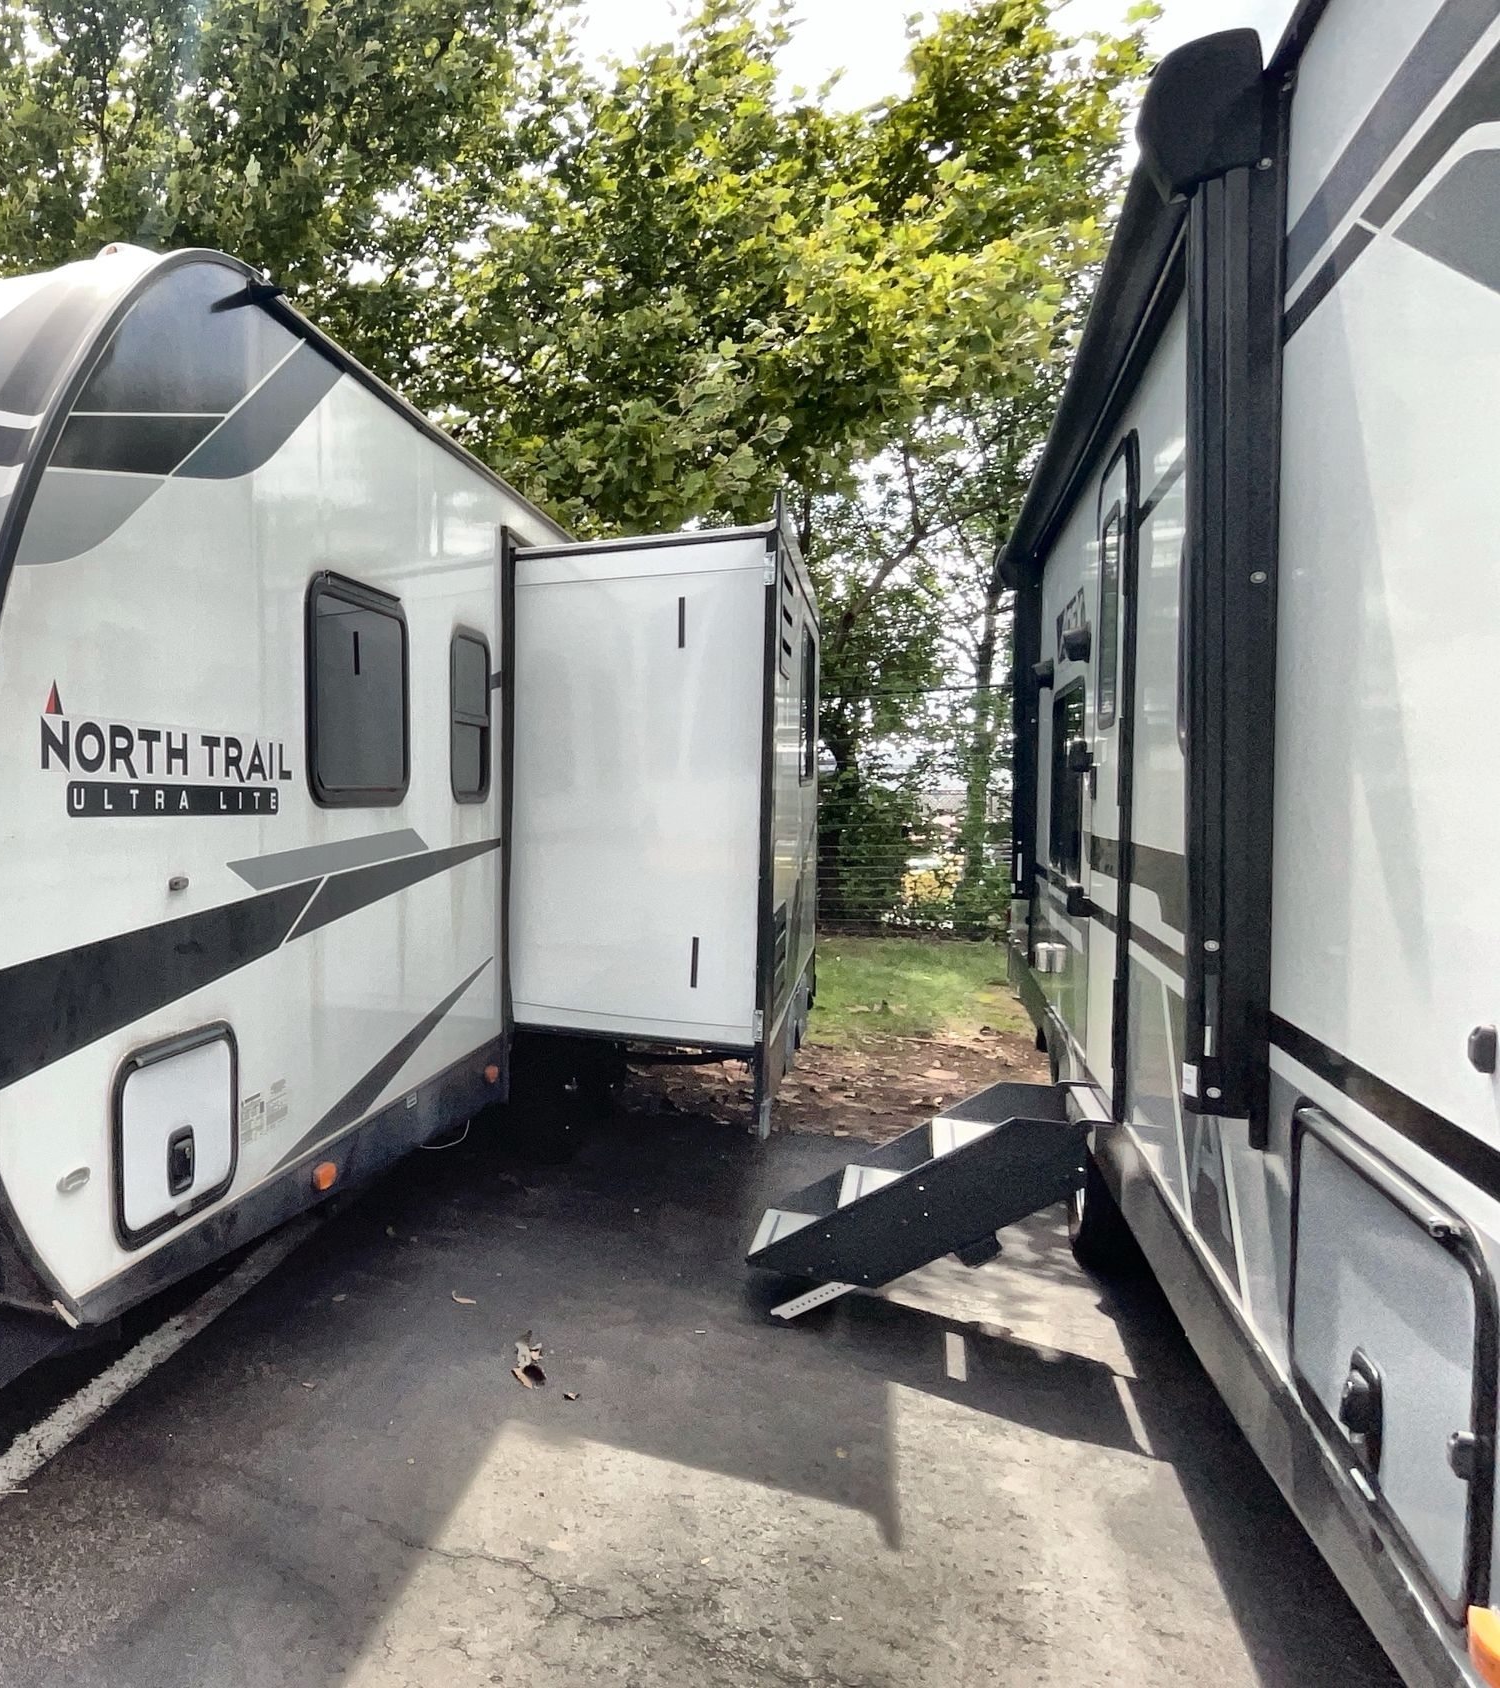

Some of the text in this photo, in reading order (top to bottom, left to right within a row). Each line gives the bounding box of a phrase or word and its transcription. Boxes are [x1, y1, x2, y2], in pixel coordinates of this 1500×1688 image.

[40, 715, 292, 783] NORTH TRAIL
[72, 787, 277, 810] ULTRA LITE
